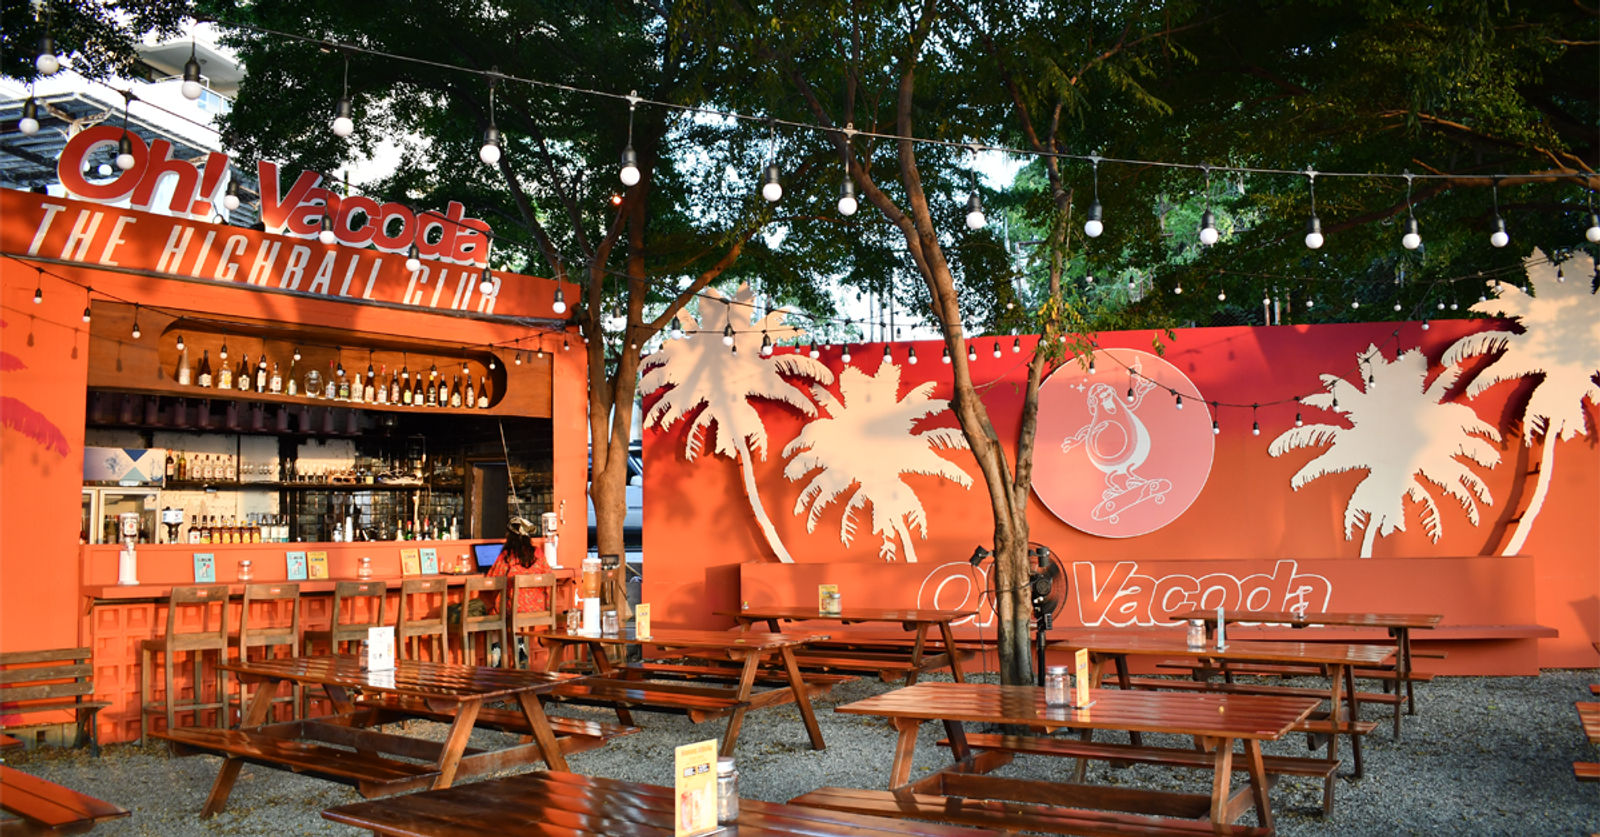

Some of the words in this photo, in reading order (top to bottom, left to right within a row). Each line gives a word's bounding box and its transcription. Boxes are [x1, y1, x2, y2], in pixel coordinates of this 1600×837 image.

[58, 125, 231, 220] Oh!
[258, 160, 492, 269] Vacoda
[27, 202, 137, 267] THE
[155, 224, 383, 300] HIGHBALL
[1073, 559, 1332, 627] Vacoda
